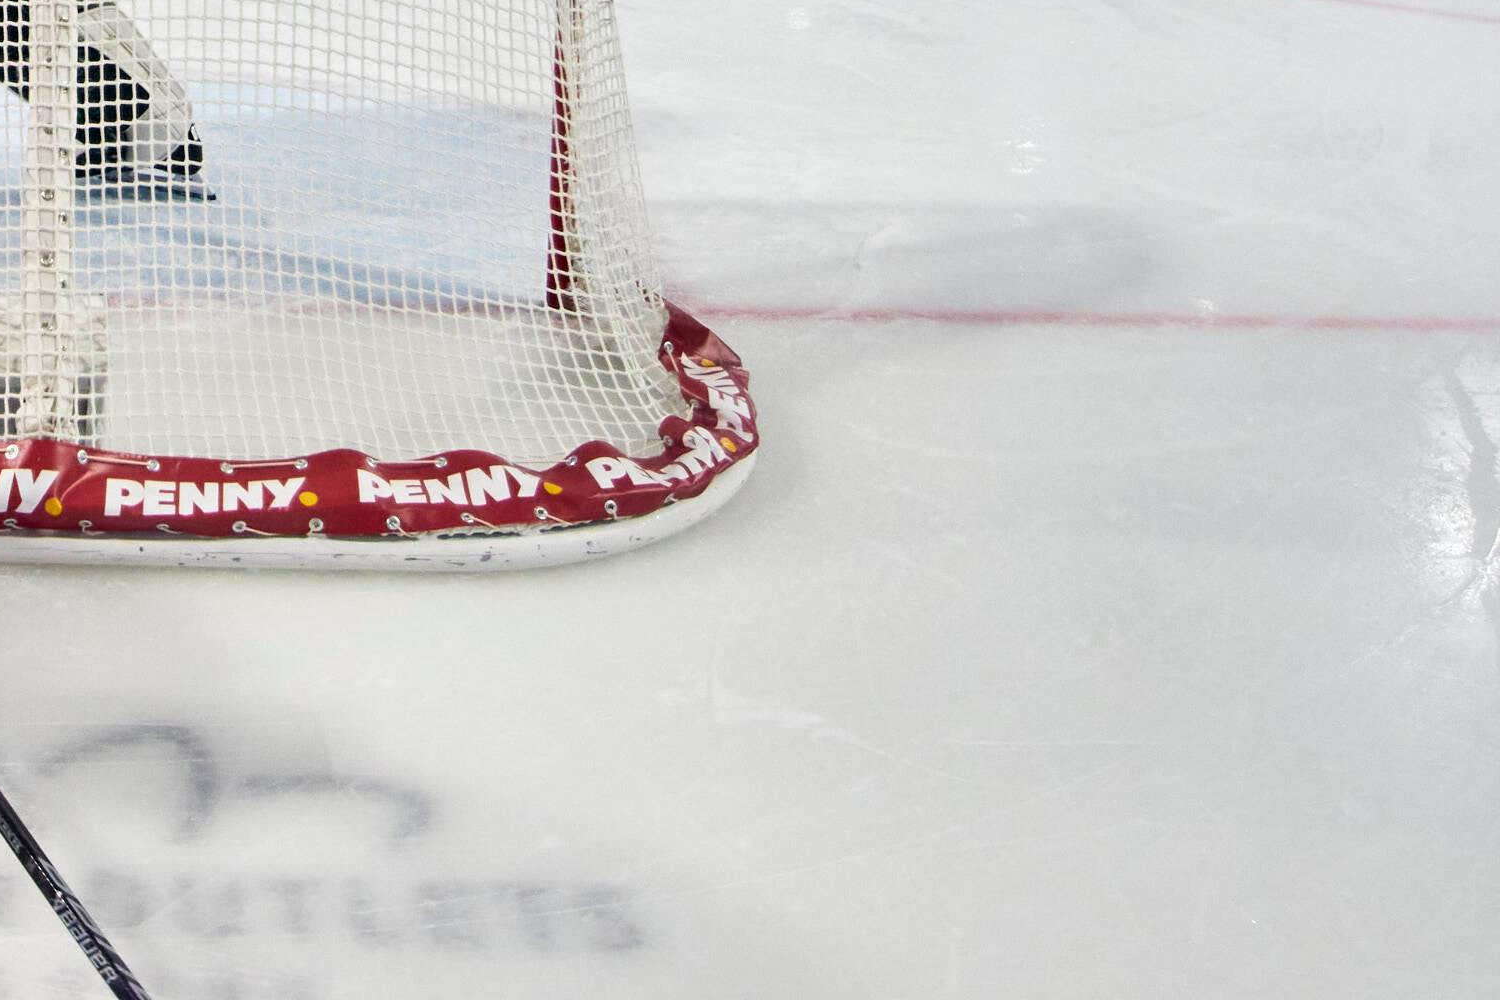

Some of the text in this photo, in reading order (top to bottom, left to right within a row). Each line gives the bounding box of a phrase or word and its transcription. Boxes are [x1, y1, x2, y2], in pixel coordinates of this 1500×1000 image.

[103, 477, 305, 517] PENNY
[358, 464, 541, 505] PENNY
[58, 906, 120, 986] BAUER
